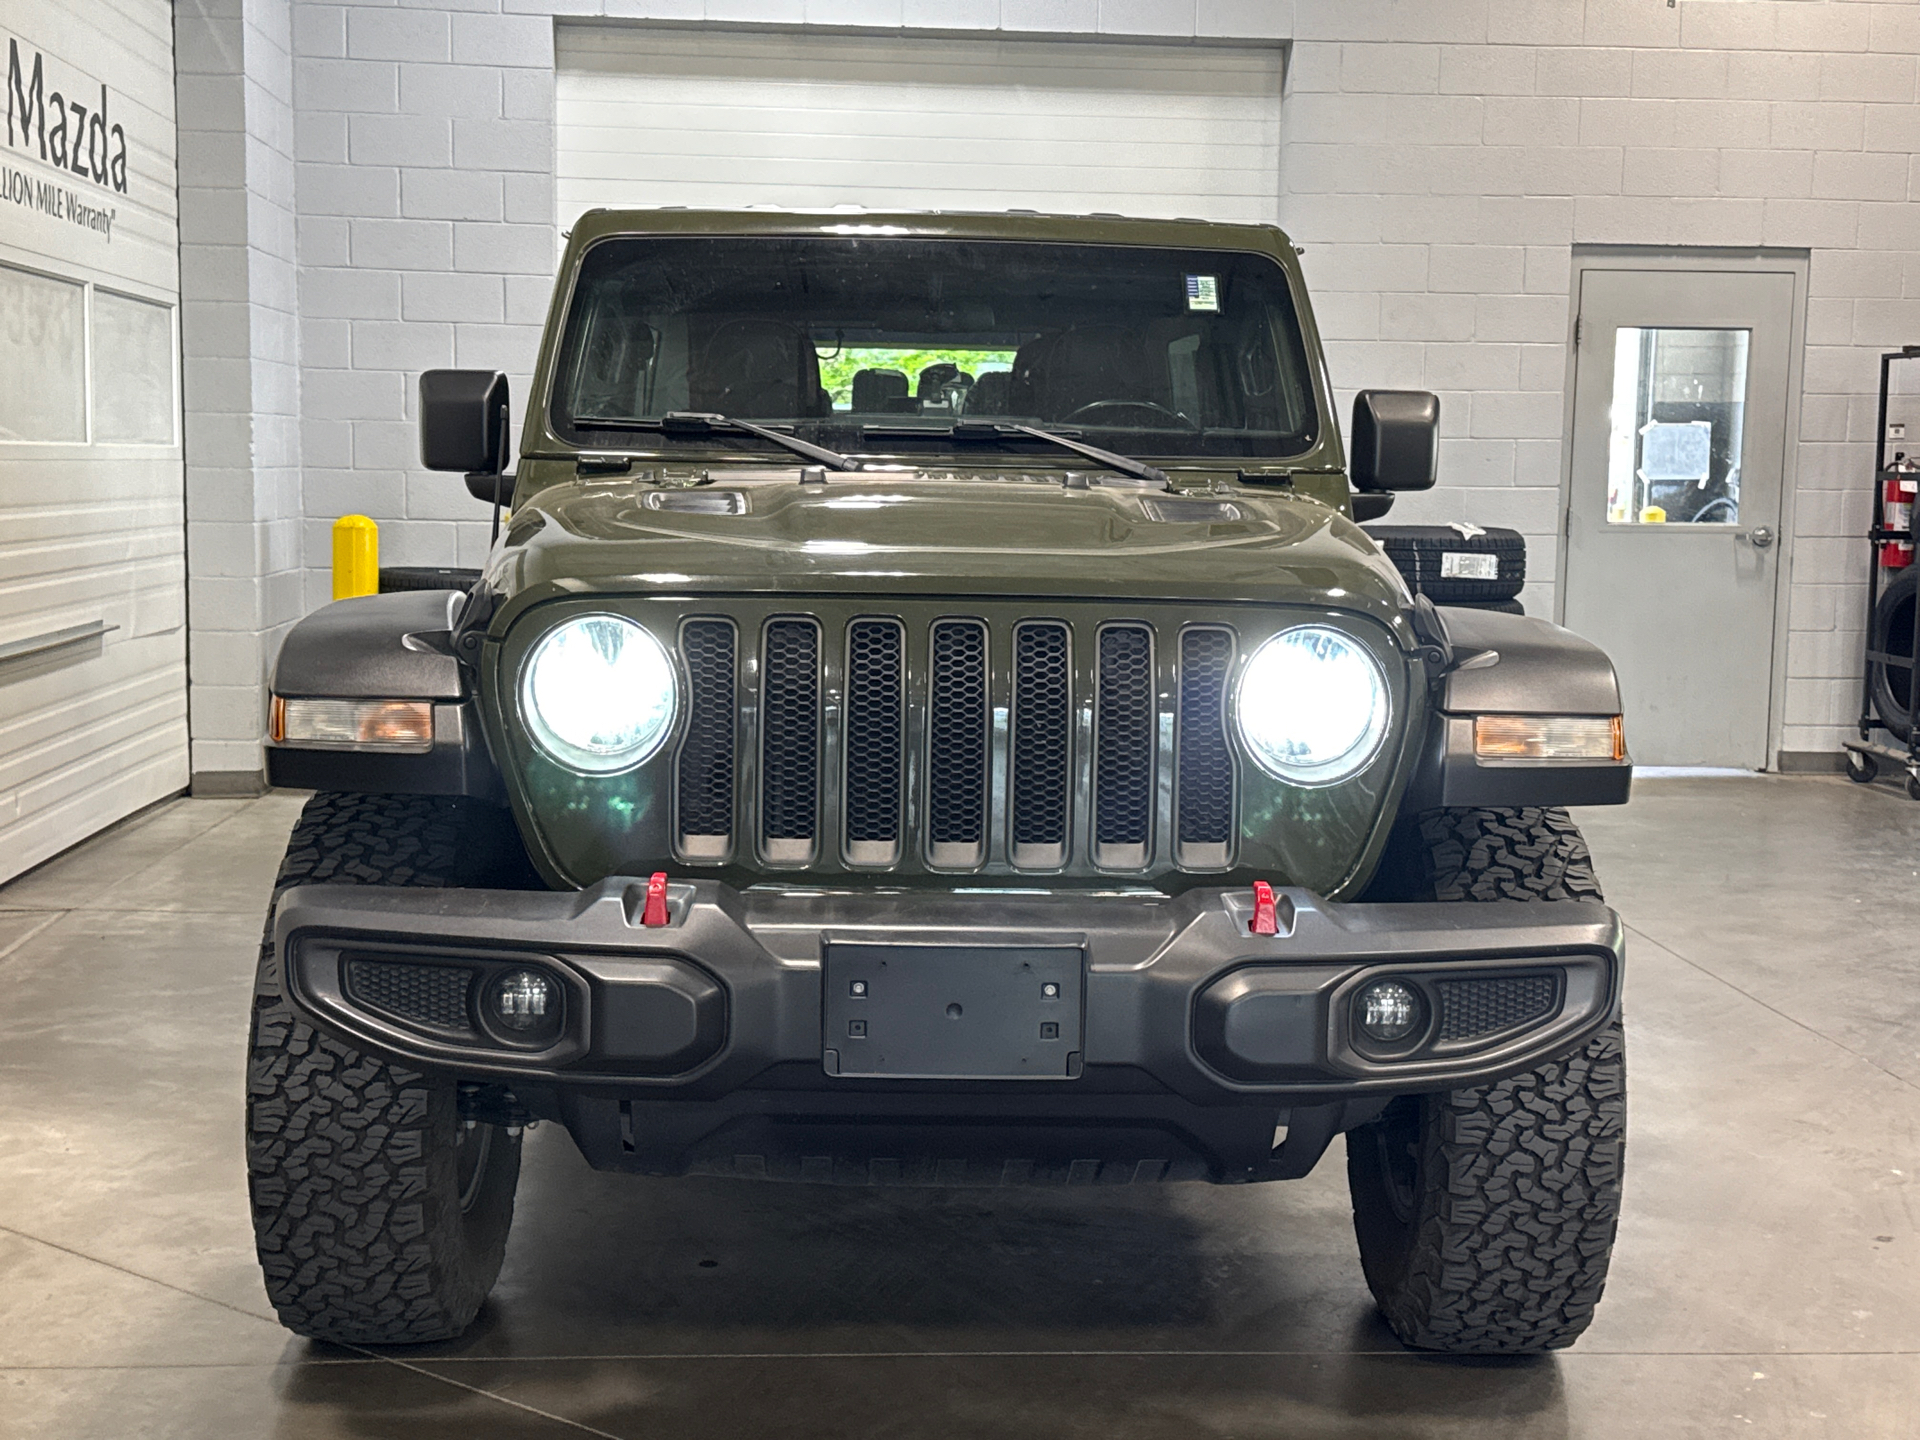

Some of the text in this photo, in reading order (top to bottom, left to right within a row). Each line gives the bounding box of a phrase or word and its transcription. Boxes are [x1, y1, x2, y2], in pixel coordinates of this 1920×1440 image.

[8, 37, 127, 194] Mazda
[0, 166, 33, 209] LION
[36, 179, 63, 219] MILE
